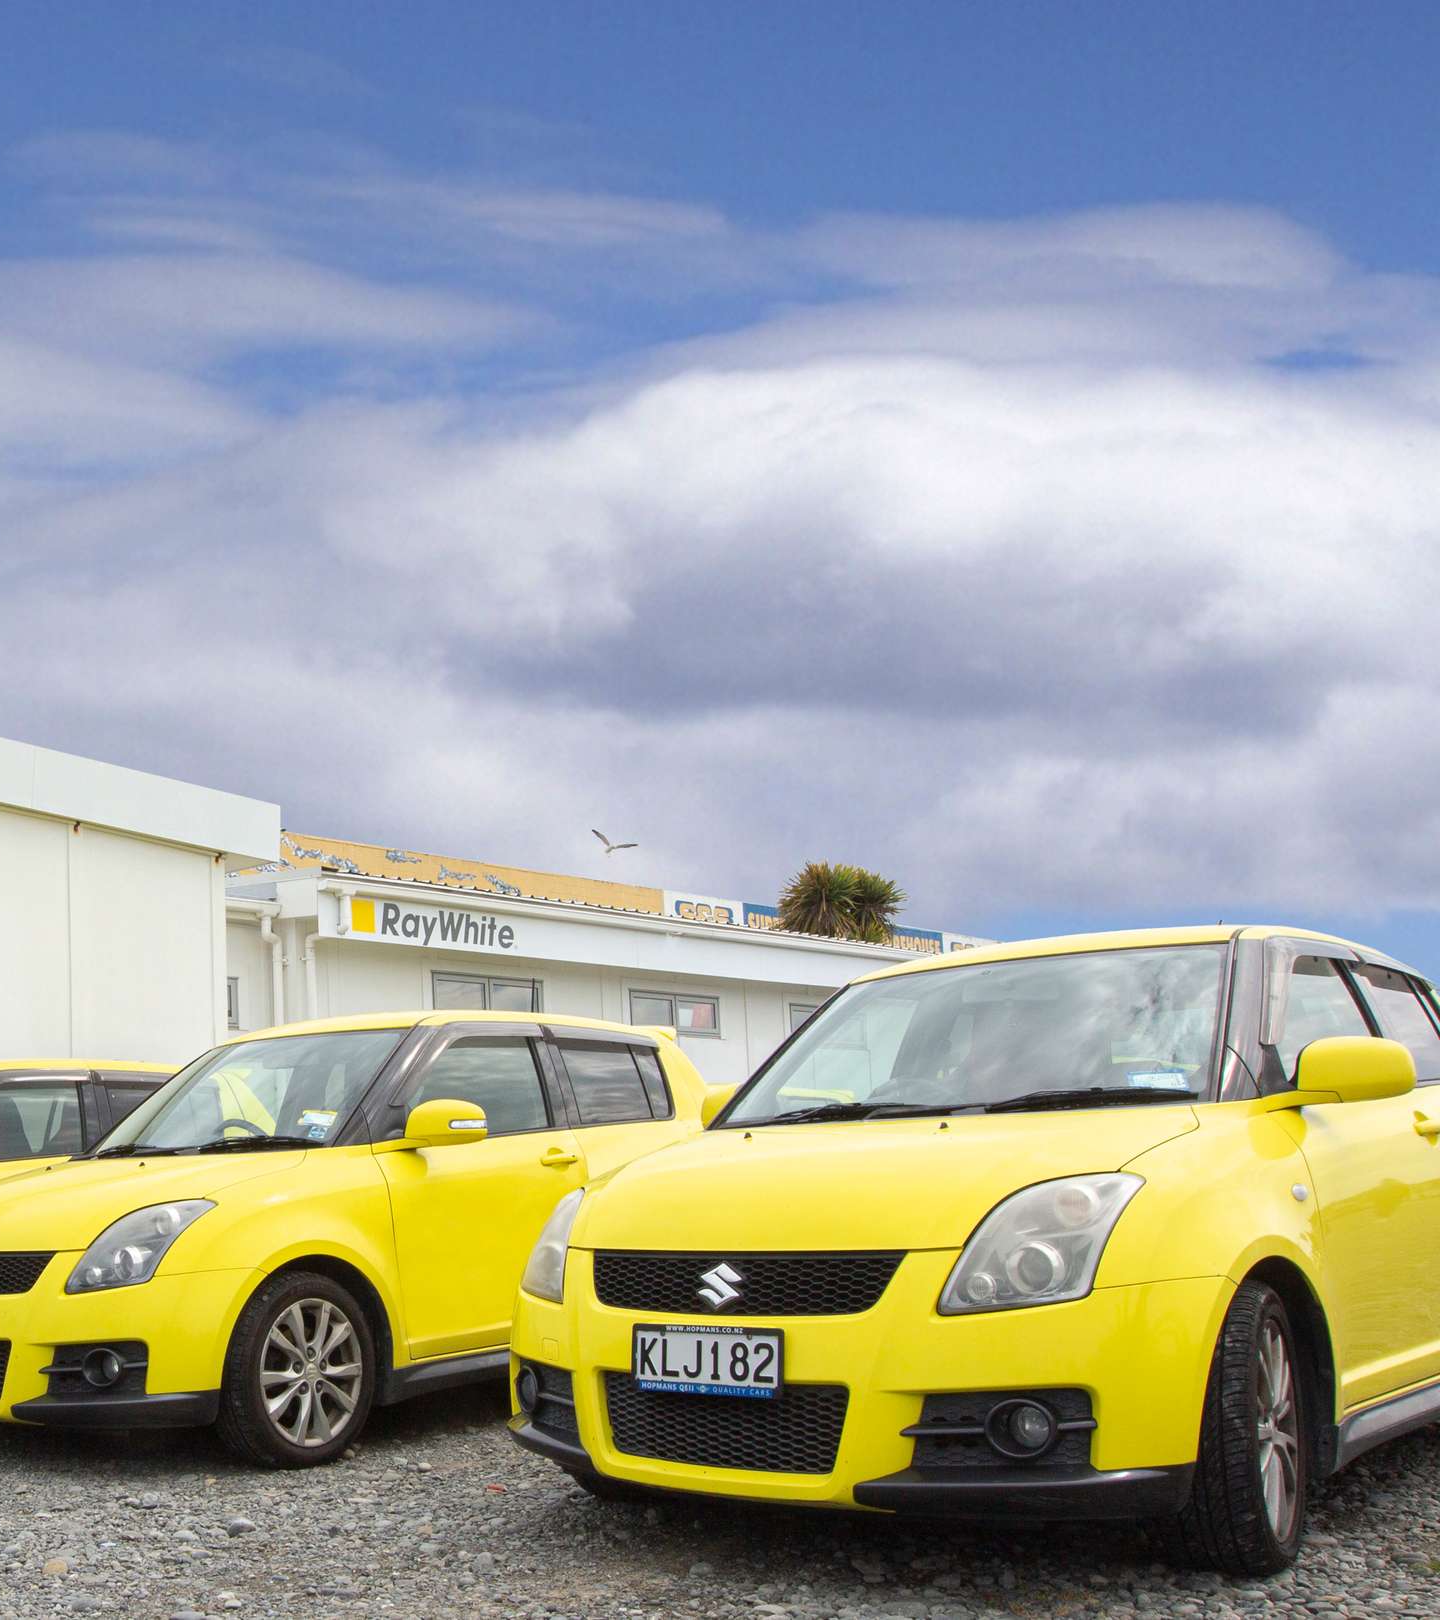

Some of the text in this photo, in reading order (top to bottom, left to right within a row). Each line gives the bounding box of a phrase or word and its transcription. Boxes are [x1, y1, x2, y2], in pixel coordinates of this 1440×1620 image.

[381, 902, 515, 949] RayWhite
[666, 1325, 744, 1334] WWW.HOPMANS.CO.NZ
[639, 1337, 775, 1384] KLJ182
[641, 1381, 677, 1392] HOPMANS
[712, 1386, 746, 1396] QUALITY
[749, 1388, 770, 1397] CARS
